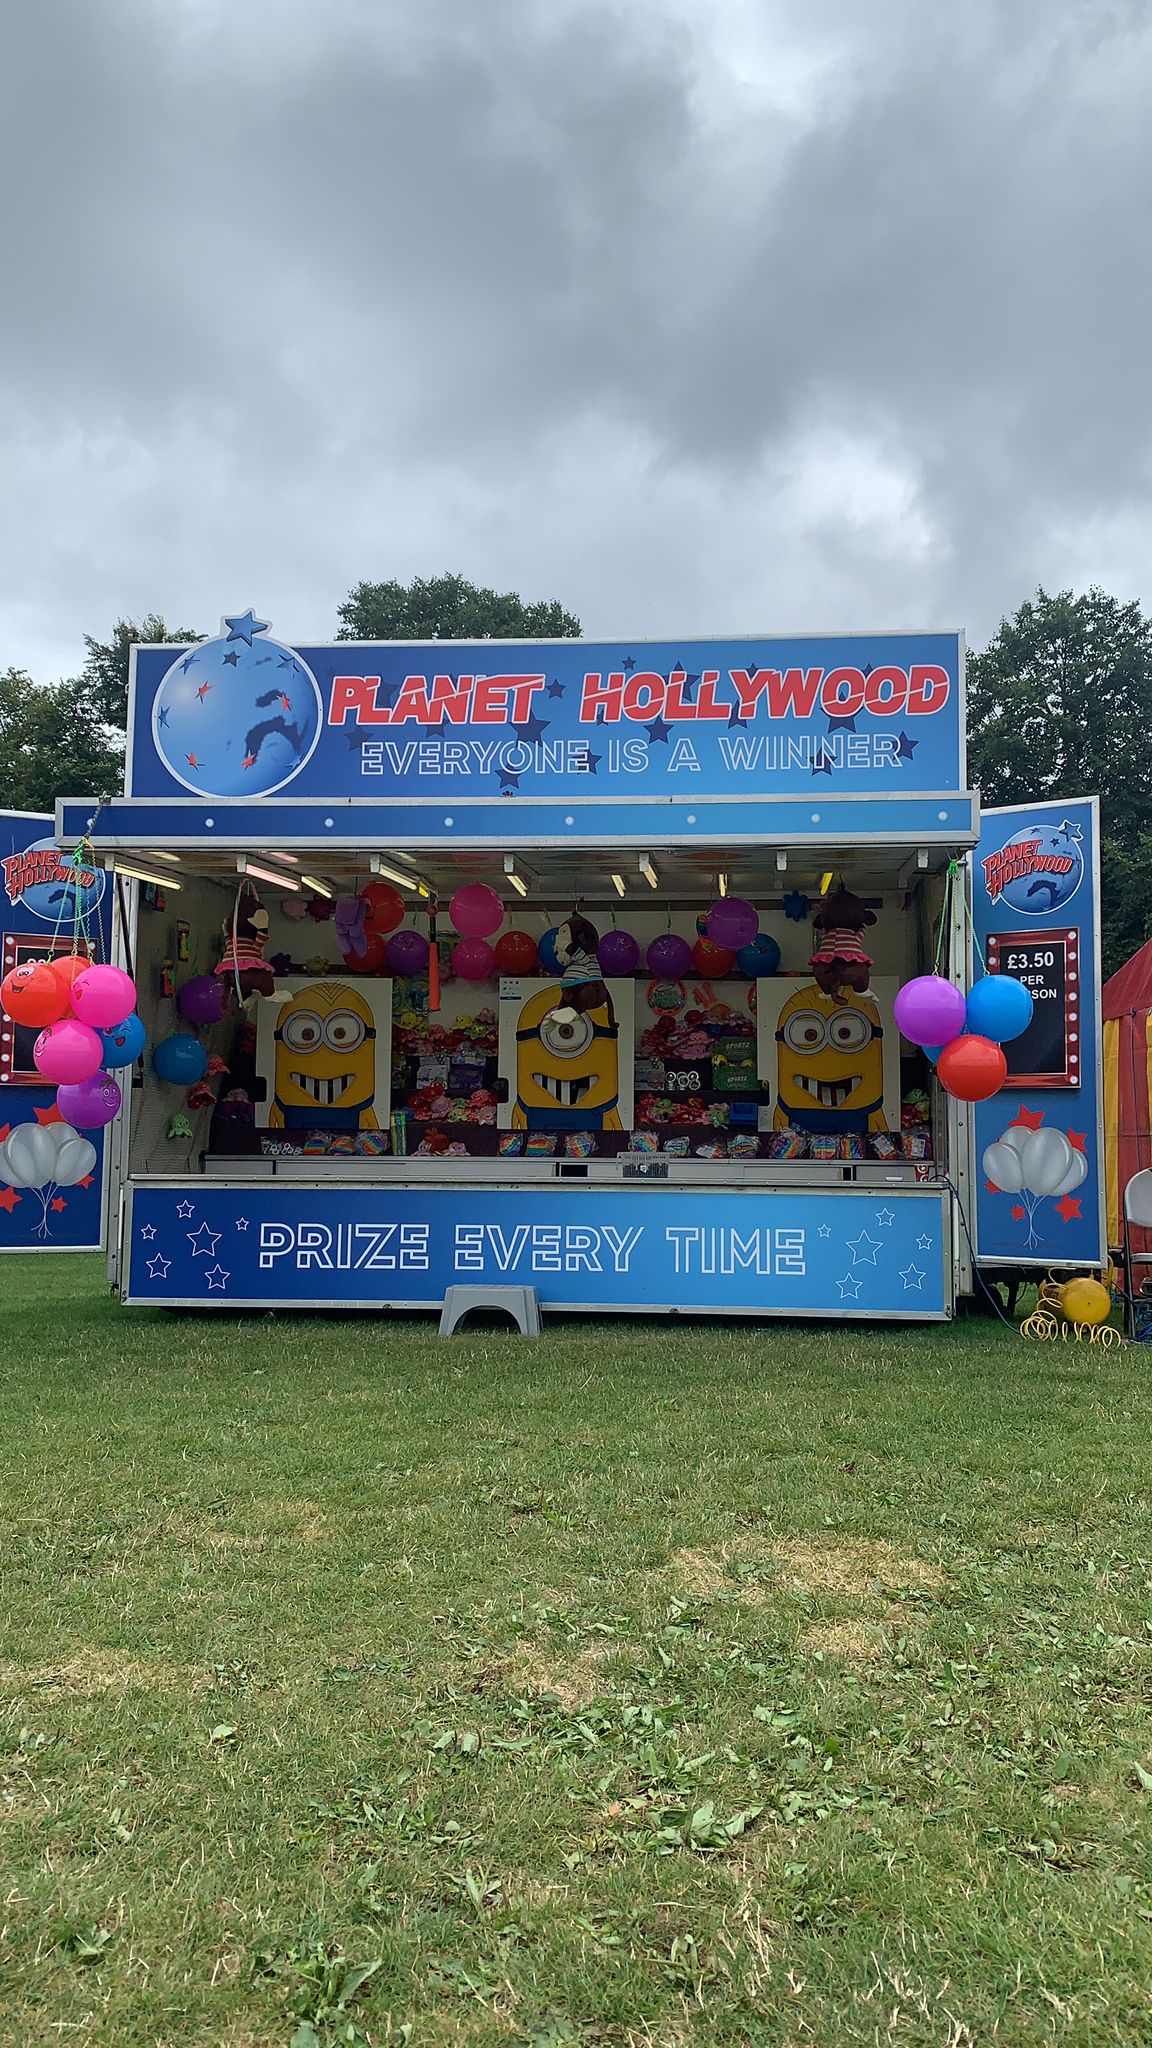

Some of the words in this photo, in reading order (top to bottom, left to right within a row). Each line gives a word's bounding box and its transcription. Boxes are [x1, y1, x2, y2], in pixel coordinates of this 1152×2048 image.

[328, 673, 546, 725] PLANET
[579, 664, 950, 723] HOLLYWOOD
[361, 739, 590, 775] EVERYONE
[609, 738, 649, 773] IS
[667, 737, 701, 772] A
[718, 733, 904, 771] WINNER
[2, 850, 64, 882] PLANET
[983, 840, 1043, 883] PLANET
[987, 854, 1073, 900] HOLLYWOOD
[1007, 951, 1054, 969] £3.50
[1020, 975, 1044, 985] PER
[1030, 989, 1057, 999] SON
[259, 1223, 430, 1270] PRIZE
[454, 1224, 645, 1273] EVERY
[665, 1226, 807, 1276] TIME
